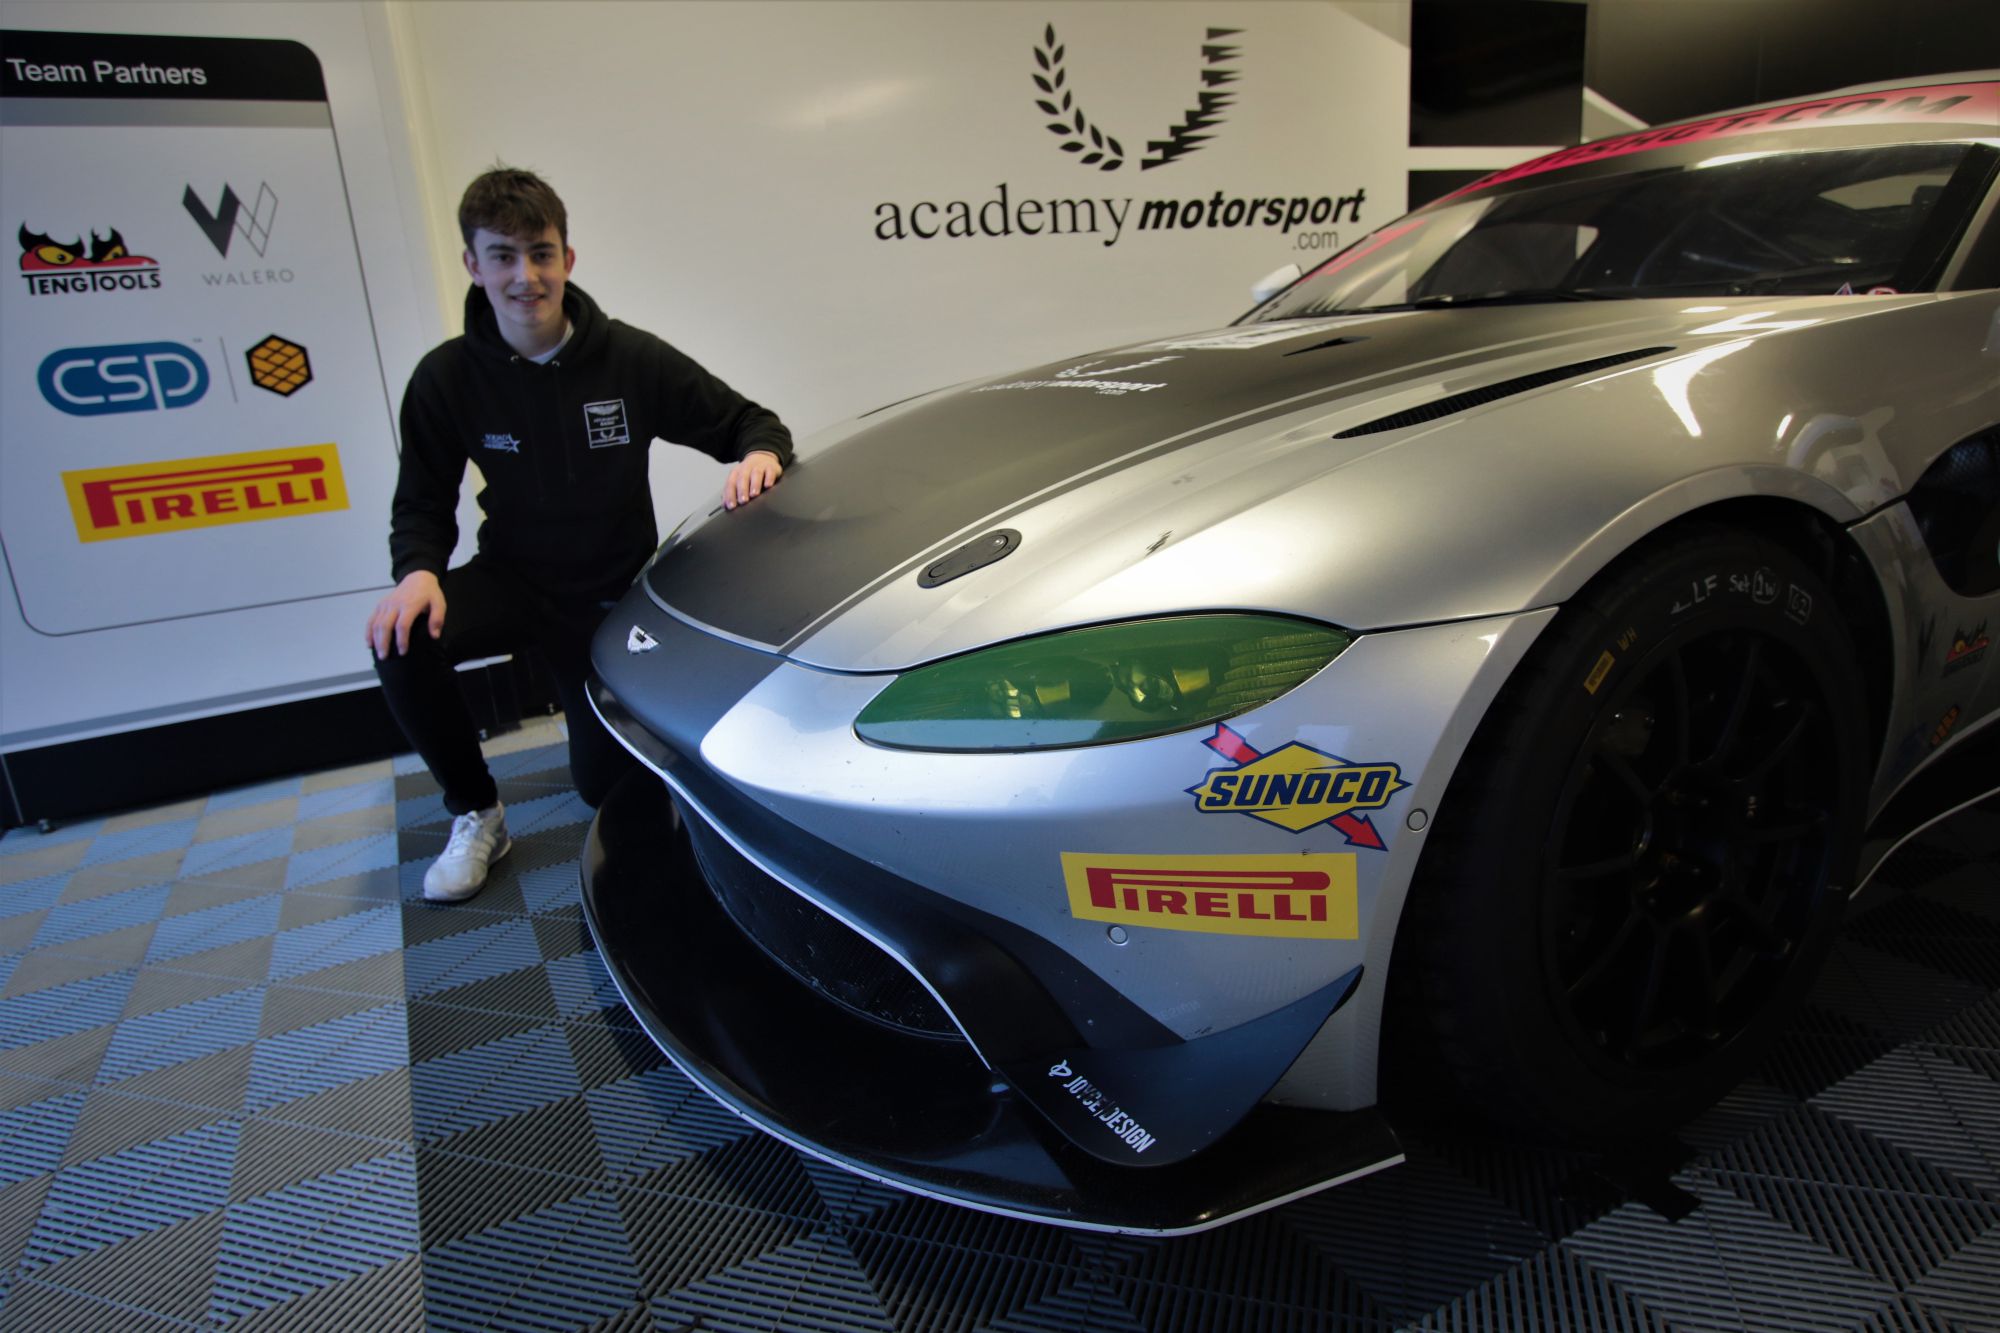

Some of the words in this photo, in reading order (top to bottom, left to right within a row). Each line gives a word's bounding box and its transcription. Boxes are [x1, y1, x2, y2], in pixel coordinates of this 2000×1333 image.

[6, 59, 87, 83] Team
[94, 61, 207, 85] Partners
[874, 183, 1133, 247] academy
[1137, 188, 1365, 233] motorsport
[1292, 229, 1339, 250] .com
[202, 268, 295, 286] WALERO
[52, 352, 199, 410] CSP
[82, 457, 325, 529] PIRELLI
[1692, 574, 1718, 603] LF
[1204, 770, 1391, 807] SUNOCO
[1086, 867, 1331, 921] PIRELLI
